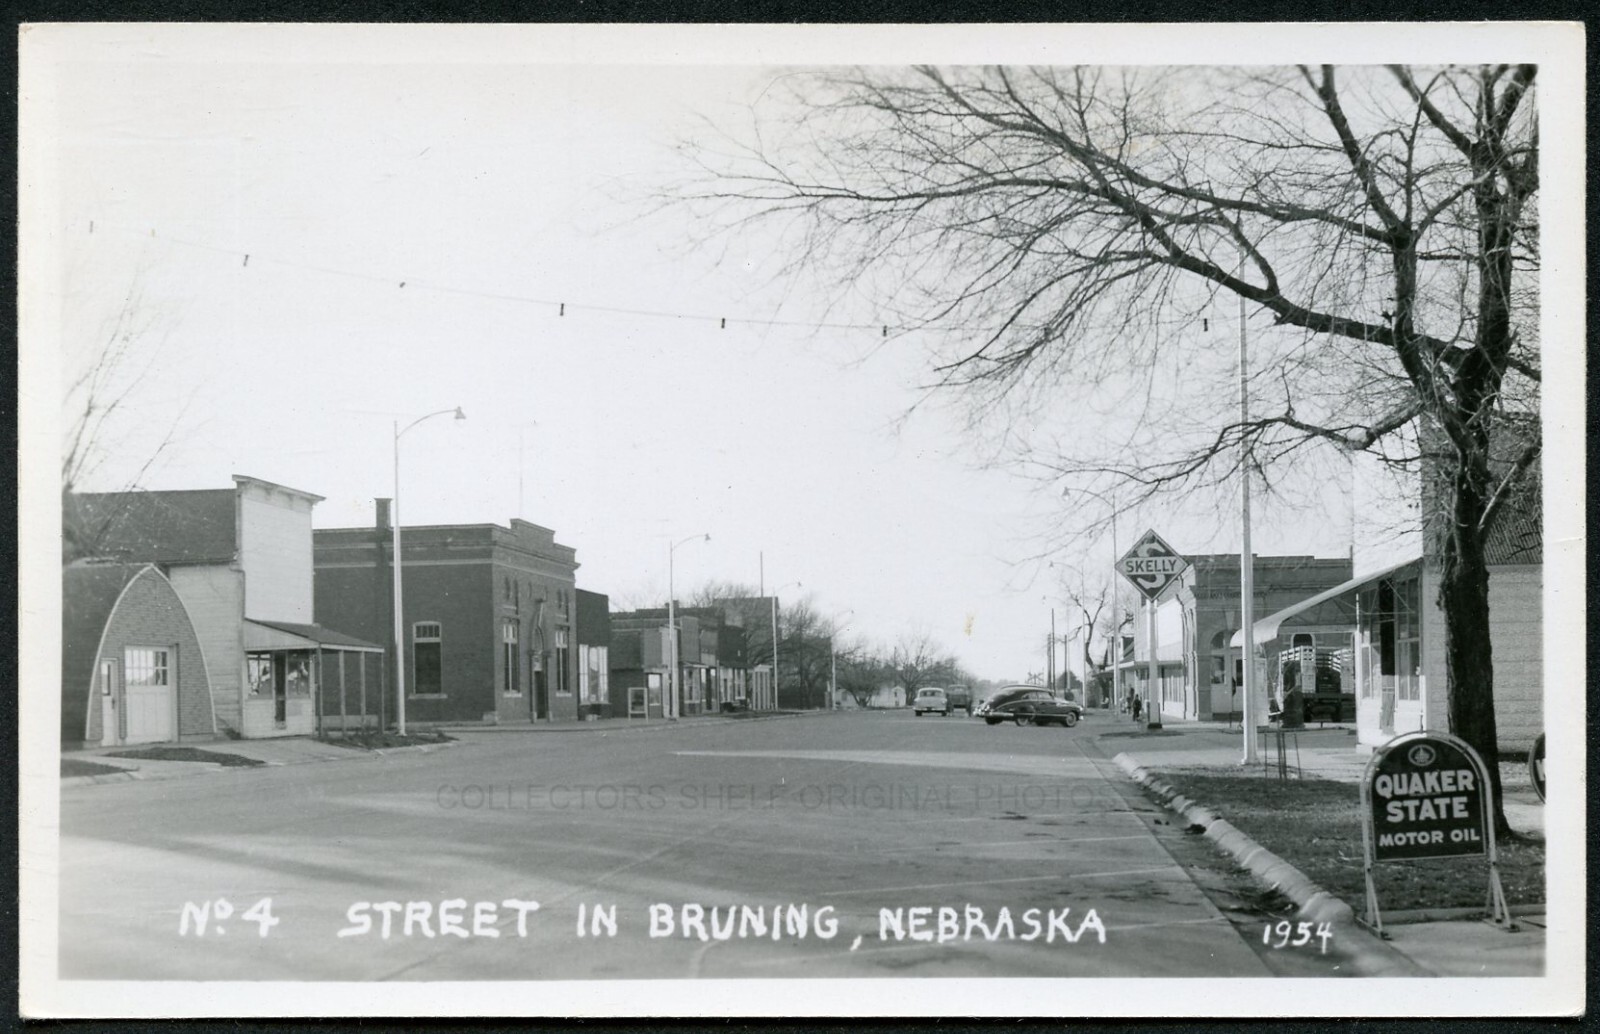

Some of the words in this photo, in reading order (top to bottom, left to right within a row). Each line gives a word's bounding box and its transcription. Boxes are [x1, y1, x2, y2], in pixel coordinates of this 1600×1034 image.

[1125, 559, 1177, 574] SKELLY
[1375, 769, 1475, 798] QUAKER
[1386, 796, 1470, 824] STATE
[1379, 830, 1444, 847] MOTOR
[1450, 828, 1480, 842] OIL
